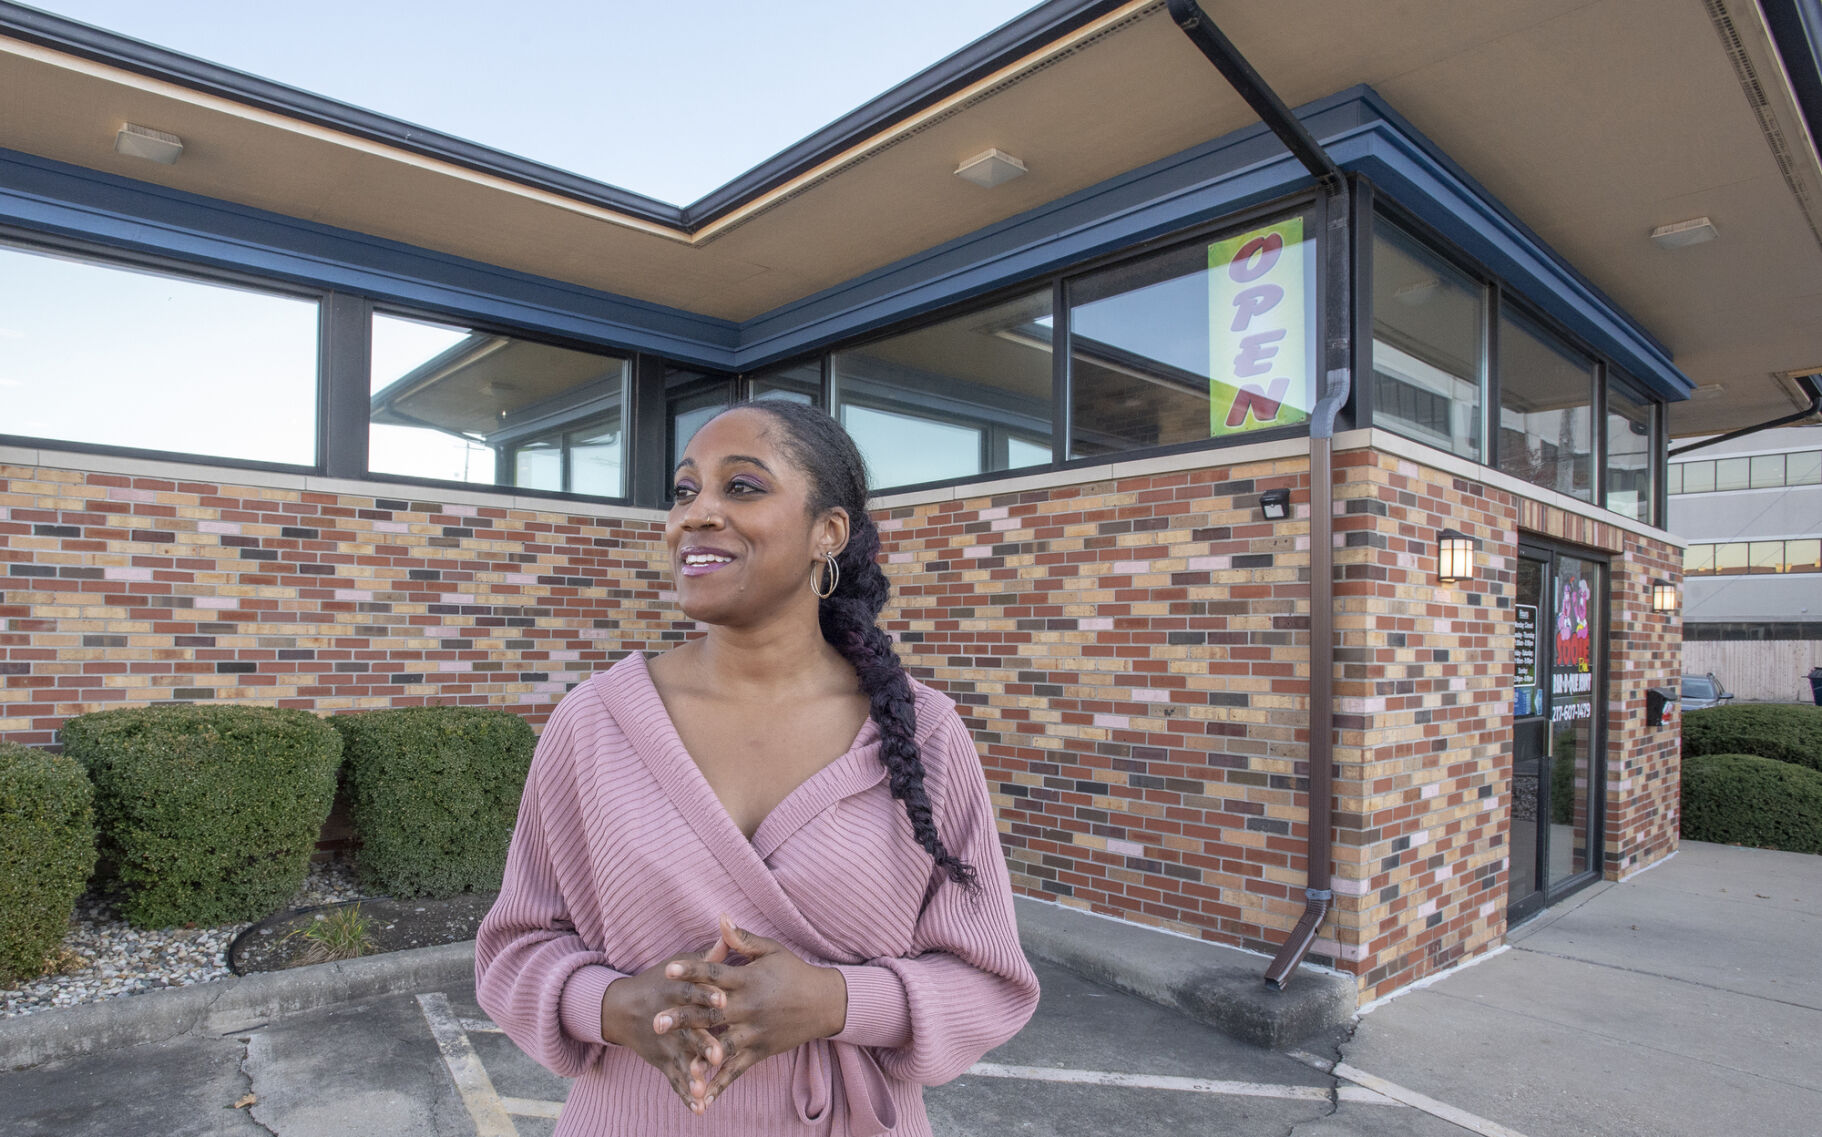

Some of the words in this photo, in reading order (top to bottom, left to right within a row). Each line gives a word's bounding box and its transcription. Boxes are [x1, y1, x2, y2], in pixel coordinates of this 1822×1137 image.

[1225, 232, 1291, 427] OPEN
[1556, 631, 1590, 665] SOOIE
[1552, 702, 1591, 722] 217-607-1479
